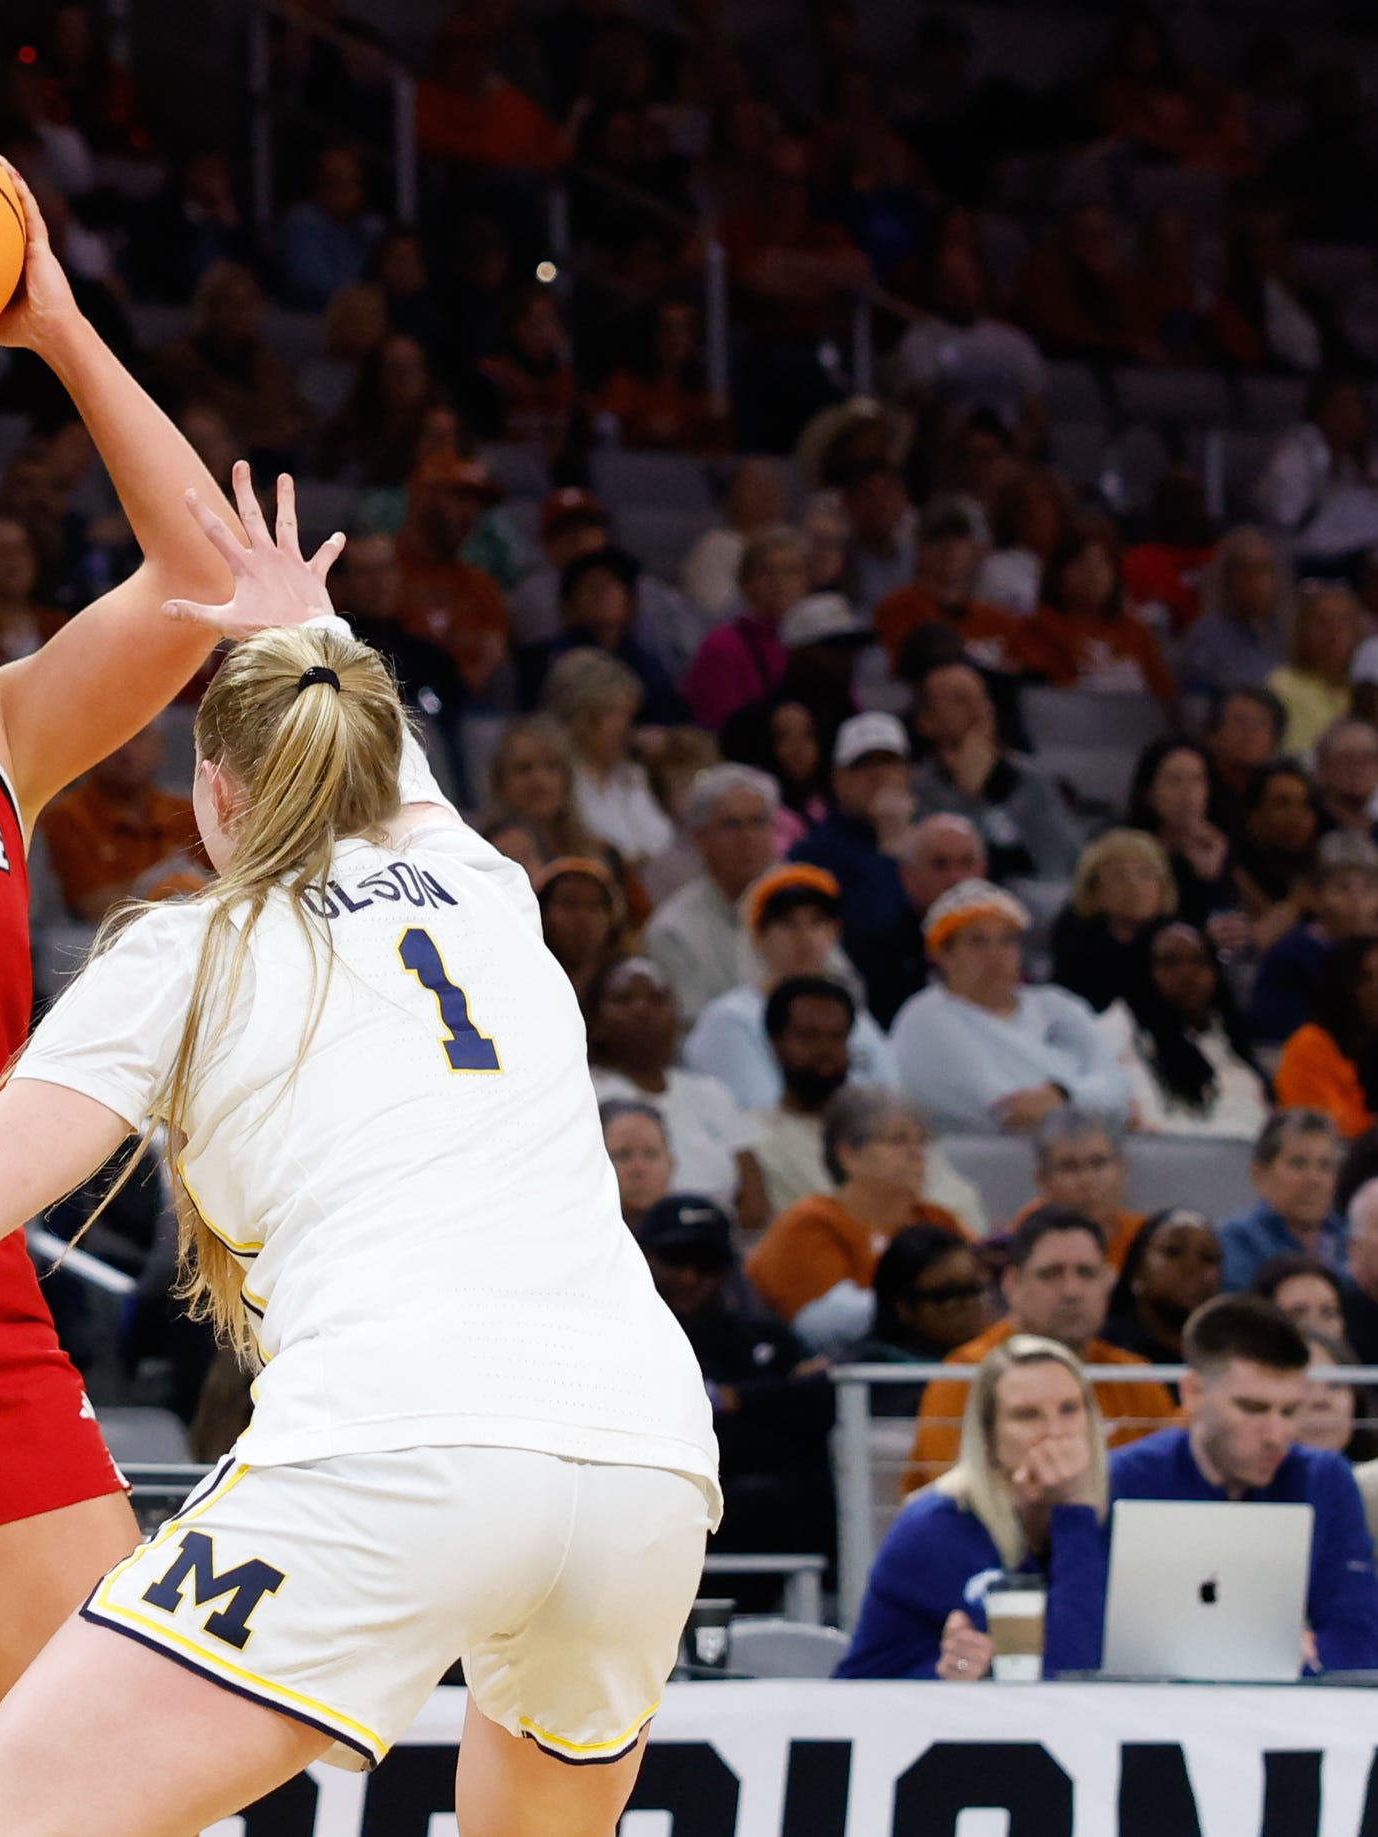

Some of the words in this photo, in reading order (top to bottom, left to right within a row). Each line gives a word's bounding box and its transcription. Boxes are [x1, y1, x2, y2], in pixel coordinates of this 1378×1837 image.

[299, 861, 459, 919] OLSON
[394, 924, 505, 1074] 1
[139, 1528, 291, 1653] M
